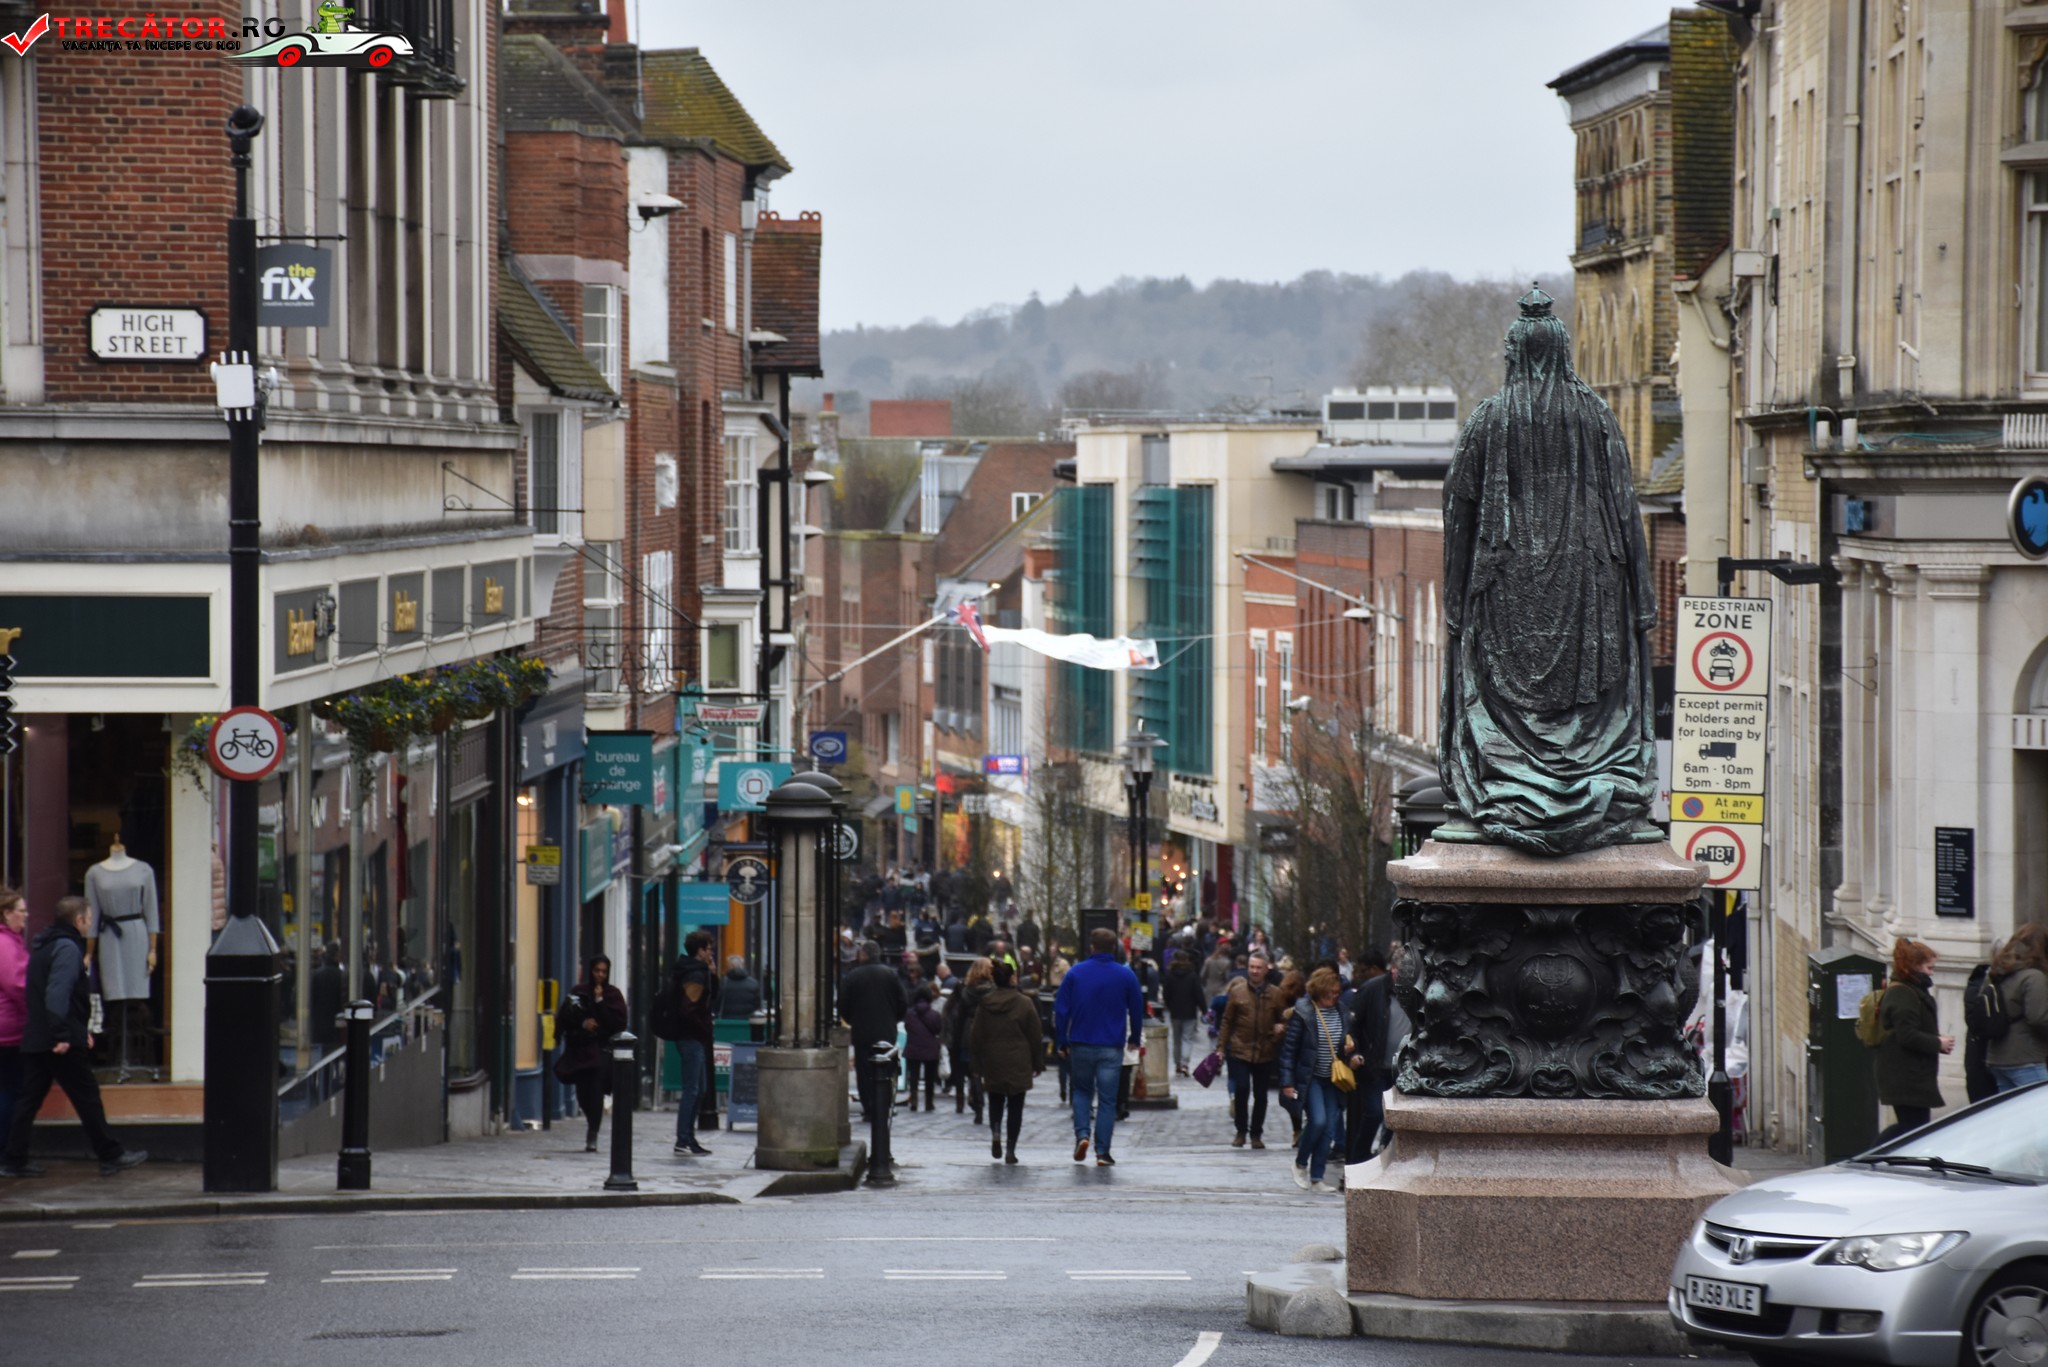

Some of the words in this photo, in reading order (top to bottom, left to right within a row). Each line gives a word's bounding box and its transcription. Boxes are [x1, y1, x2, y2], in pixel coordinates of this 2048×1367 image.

[288, 263, 316, 277] the
[260, 266, 315, 300] fix
[121, 314, 174, 332] HIGH
[108, 335, 188, 354] STREET
[1683, 600, 1766, 612] PEDESTRIAN
[1694, 613, 1753, 629] ZONE
[1679, 698, 1720, 711] Except
[1723, 700, 1764, 712] permit
[1685, 713, 1730, 724] holders
[1733, 715, 1755, 725] and
[1678, 727, 1695, 737] for
[1699, 727, 1743, 740] loading
[1747, 729, 1761, 741] by
[595, 750, 640, 763] bureau
[608, 764, 626, 777] de
[1683, 762, 1709, 773] 6am
[1721, 764, 1754, 775] 10am
[1685, 777, 1712, 788] 5pm
[1724, 778, 1751, 790] 8pm
[1715, 797, 1728, 807] At
[1732, 800, 1753, 809] any
[1720, 810, 1746, 820] time
[1725, 1285, 1754, 1311] XLE
